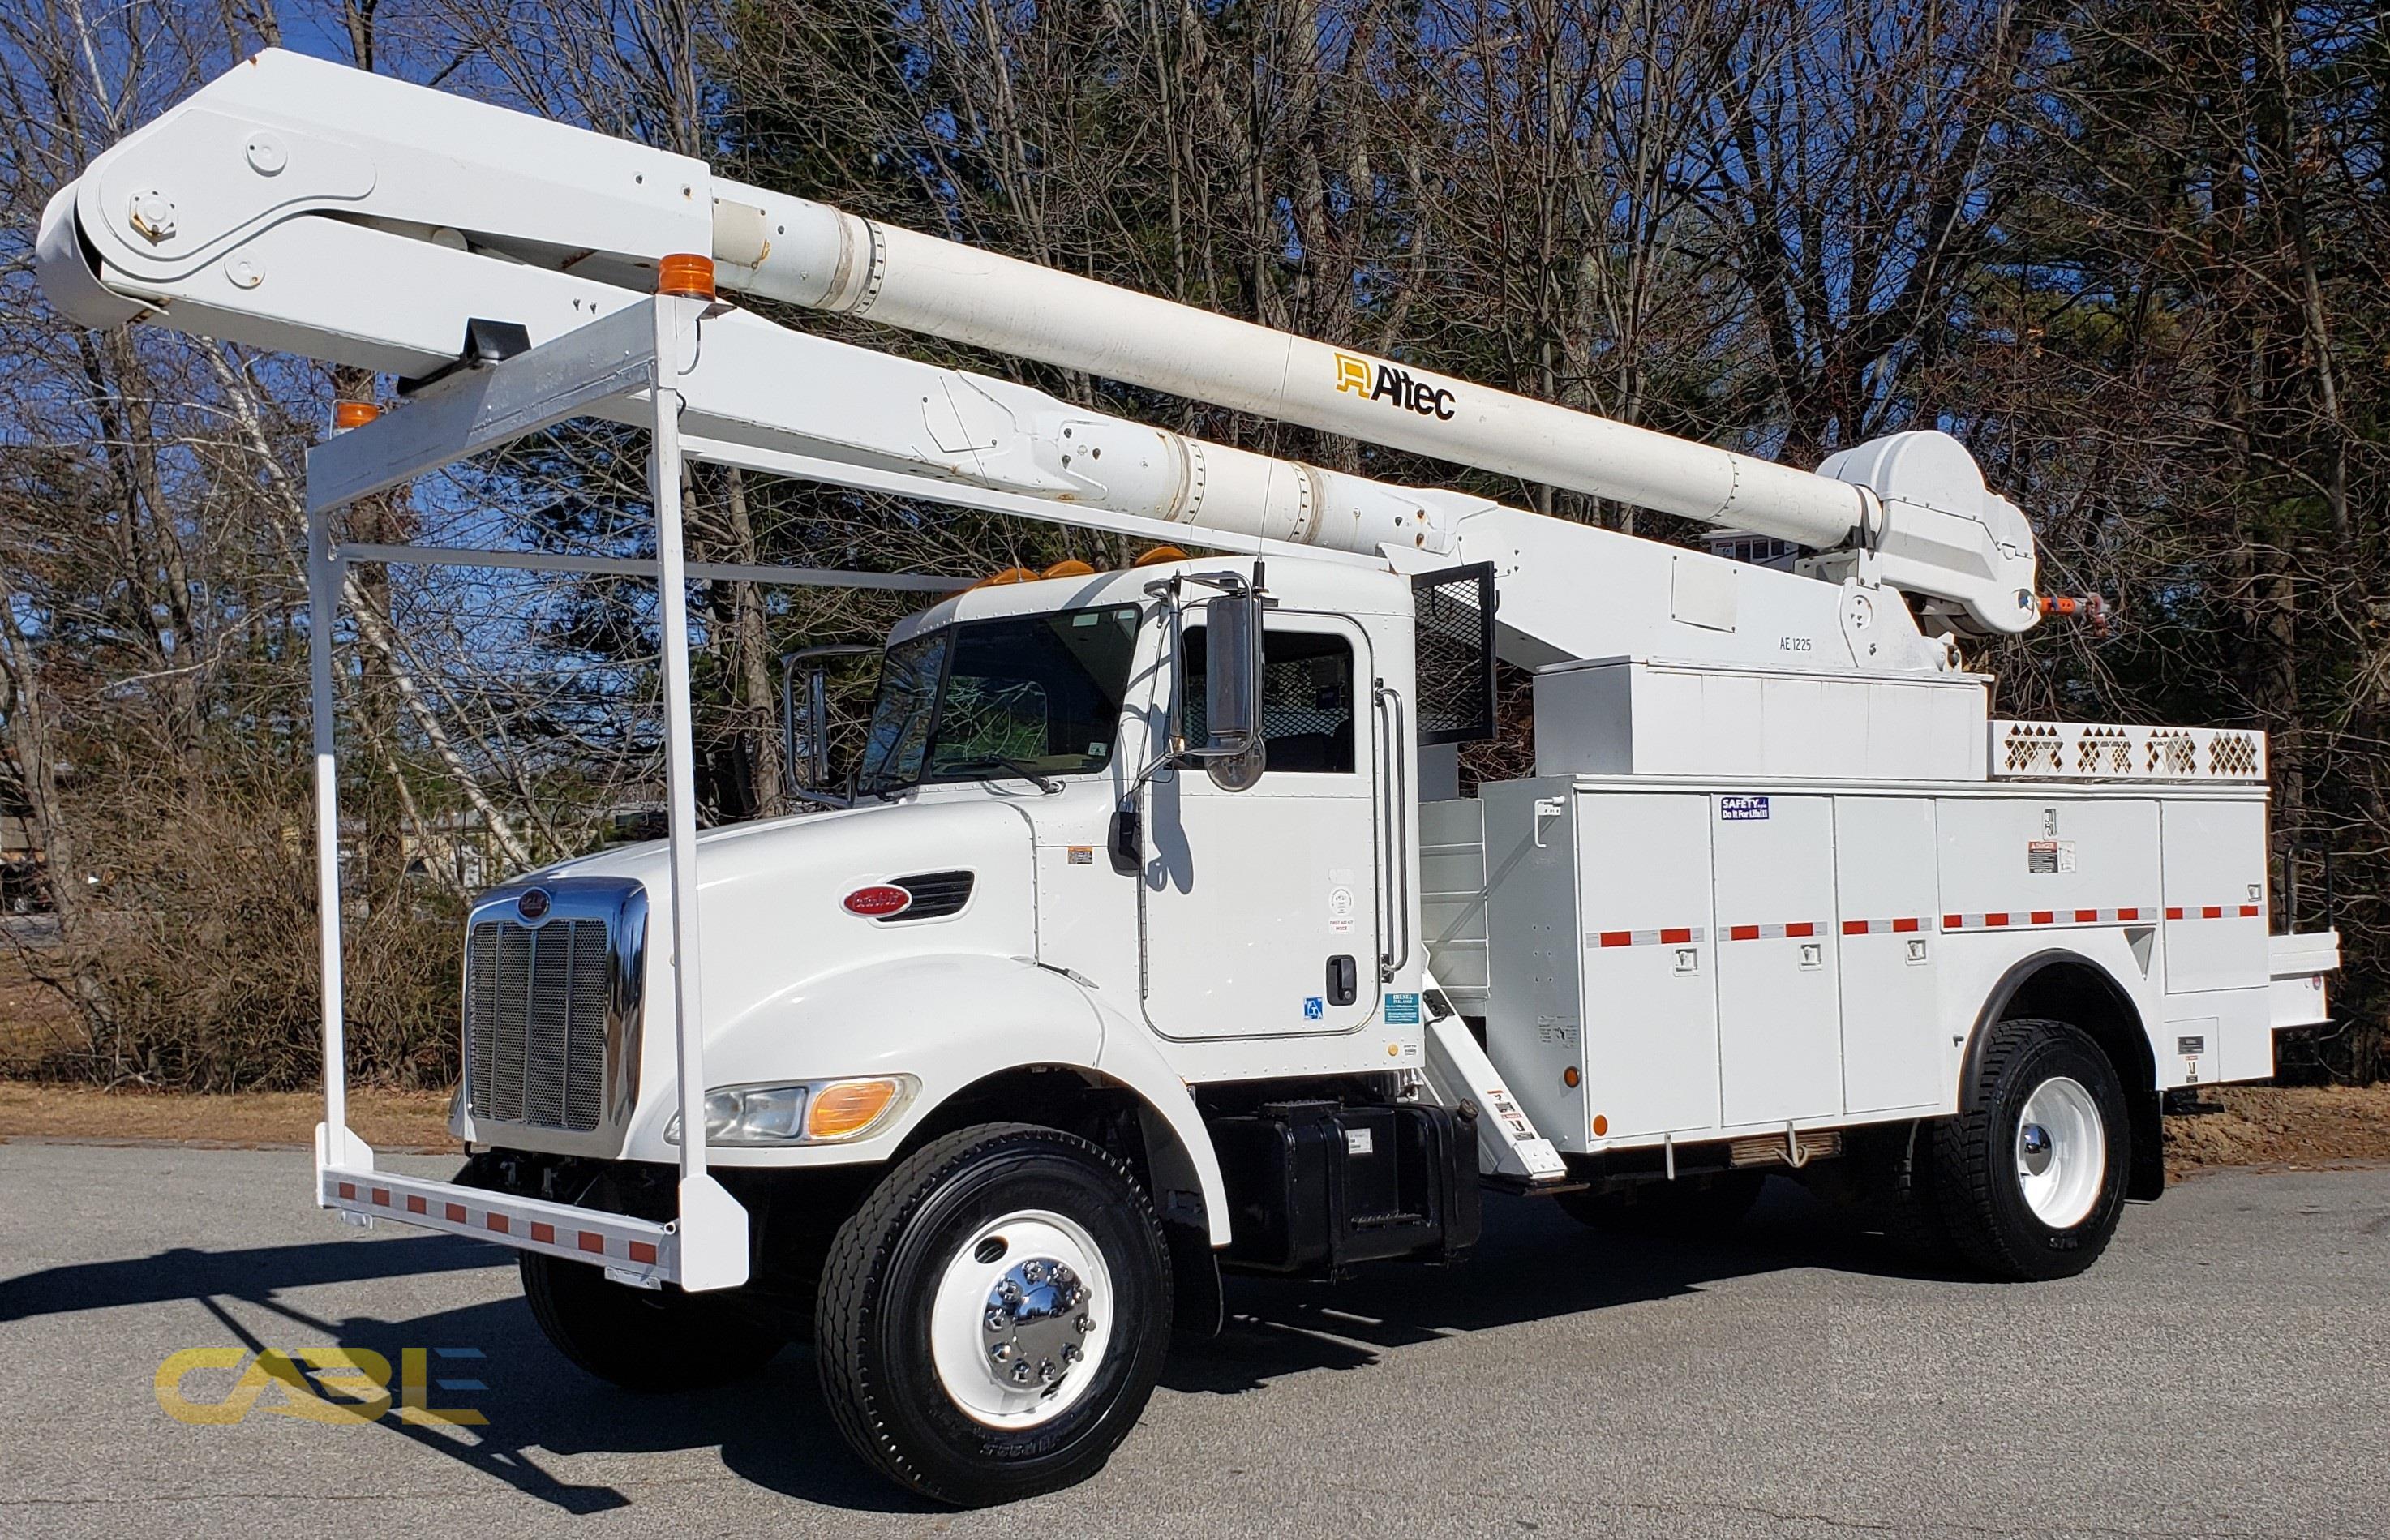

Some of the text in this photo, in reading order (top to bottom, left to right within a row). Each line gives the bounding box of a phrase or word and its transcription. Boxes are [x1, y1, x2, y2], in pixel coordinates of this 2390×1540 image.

[1371, 364, 1455, 420] Altec
[1780, 637, 1811, 651] AE 1225
[1723, 799, 1759, 809] SAFETY
[1723, 810, 1731, 818] Do
[1738, 810, 1749, 818] For
